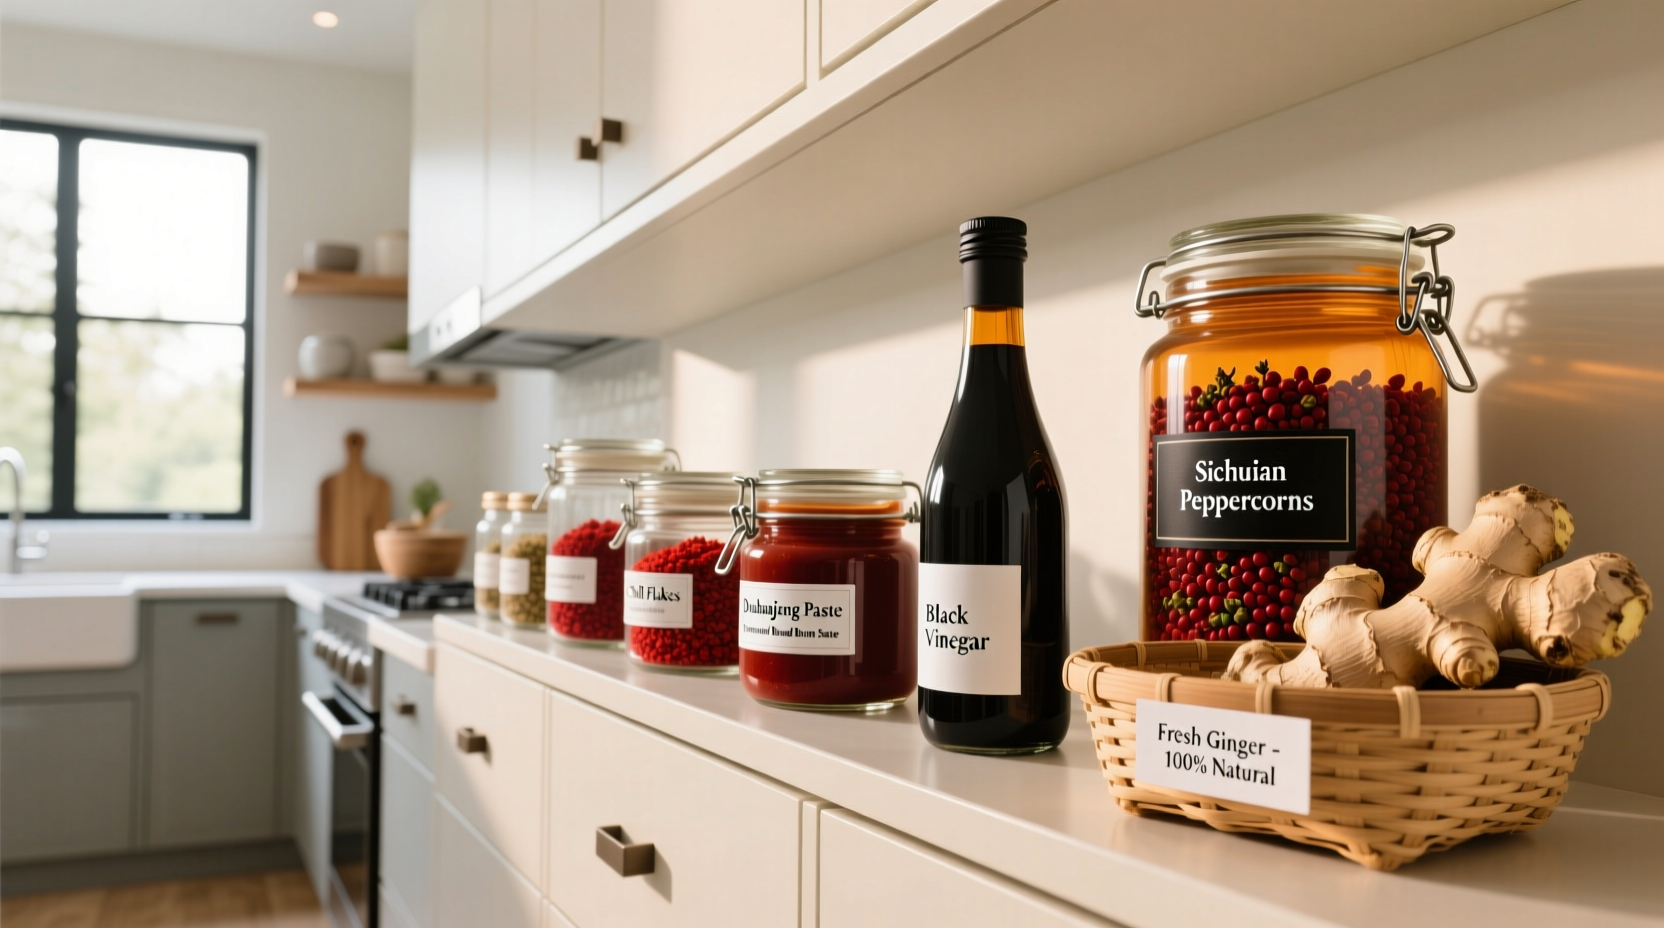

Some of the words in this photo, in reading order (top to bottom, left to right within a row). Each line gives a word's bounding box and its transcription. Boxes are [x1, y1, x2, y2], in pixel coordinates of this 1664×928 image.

[1195, 458, 1287, 482] Sichuian
[1180, 488, 1314, 518] Peppercorns
[803, 601, 843, 618] Paste
[926, 603, 969, 625] Black
[924, 628, 990, 656] Vinegar
[1158, 722, 1202, 747] Fresh
[1206, 730, 1266, 760] Ginger
[1165, 750, 1207, 774] 100%
[1212, 757, 1276, 786] Natural
